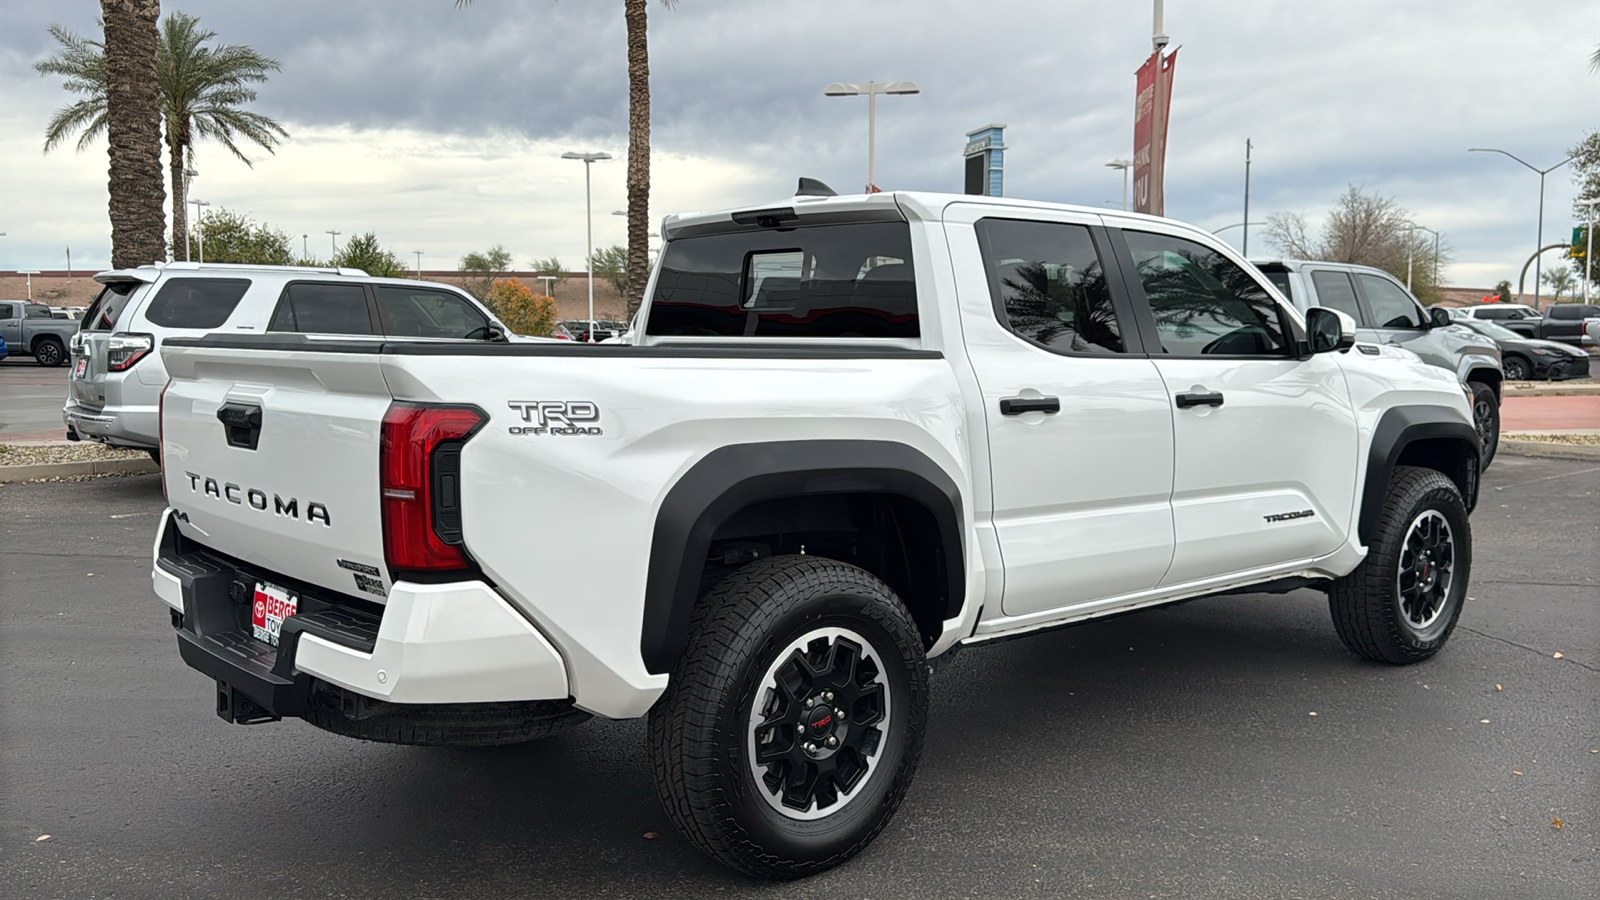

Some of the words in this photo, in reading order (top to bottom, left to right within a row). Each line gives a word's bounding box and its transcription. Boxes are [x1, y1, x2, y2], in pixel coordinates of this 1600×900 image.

[507, 400, 600, 428] TRD
[508, 426, 548, 436] OFF
[550, 426, 603, 436] ROAD
[185, 470, 331, 527] TACOMA
[1263, 509, 1315, 523] TACOMA
[267, 595, 297, 620] BERGE
[266, 617, 281, 634] TOY
[811, 715, 832, 729] TRD
